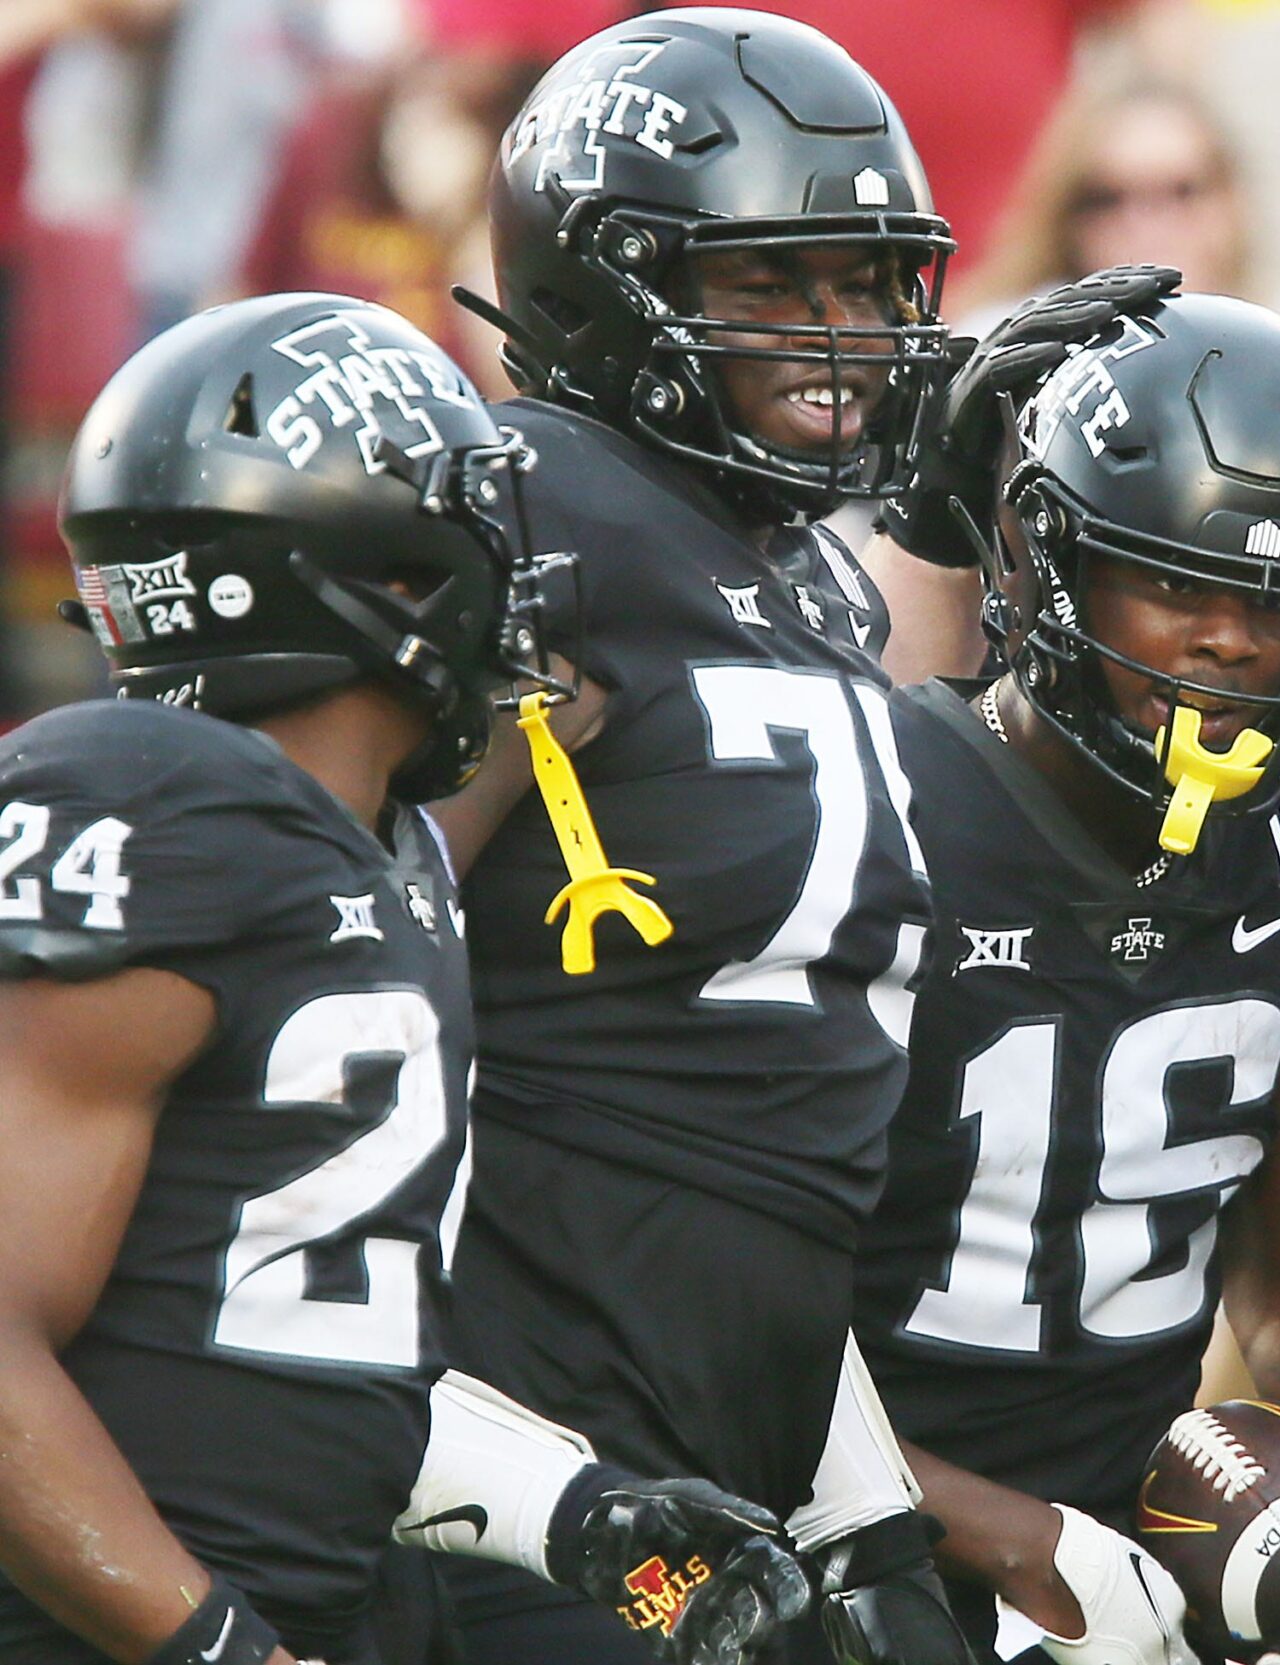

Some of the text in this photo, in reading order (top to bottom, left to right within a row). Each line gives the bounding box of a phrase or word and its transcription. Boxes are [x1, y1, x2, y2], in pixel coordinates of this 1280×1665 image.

[266, 346, 477, 470] STATE
[127, 555, 192, 601] XII
[146, 600, 196, 635] 24
[715, 582, 771, 629] XII
[0, 801, 134, 930] 24
[330, 894, 384, 942] XII
[1110, 930, 1166, 953] STATE
[955, 926, 1033, 972] XII
[213, 990, 476, 1368] 2
